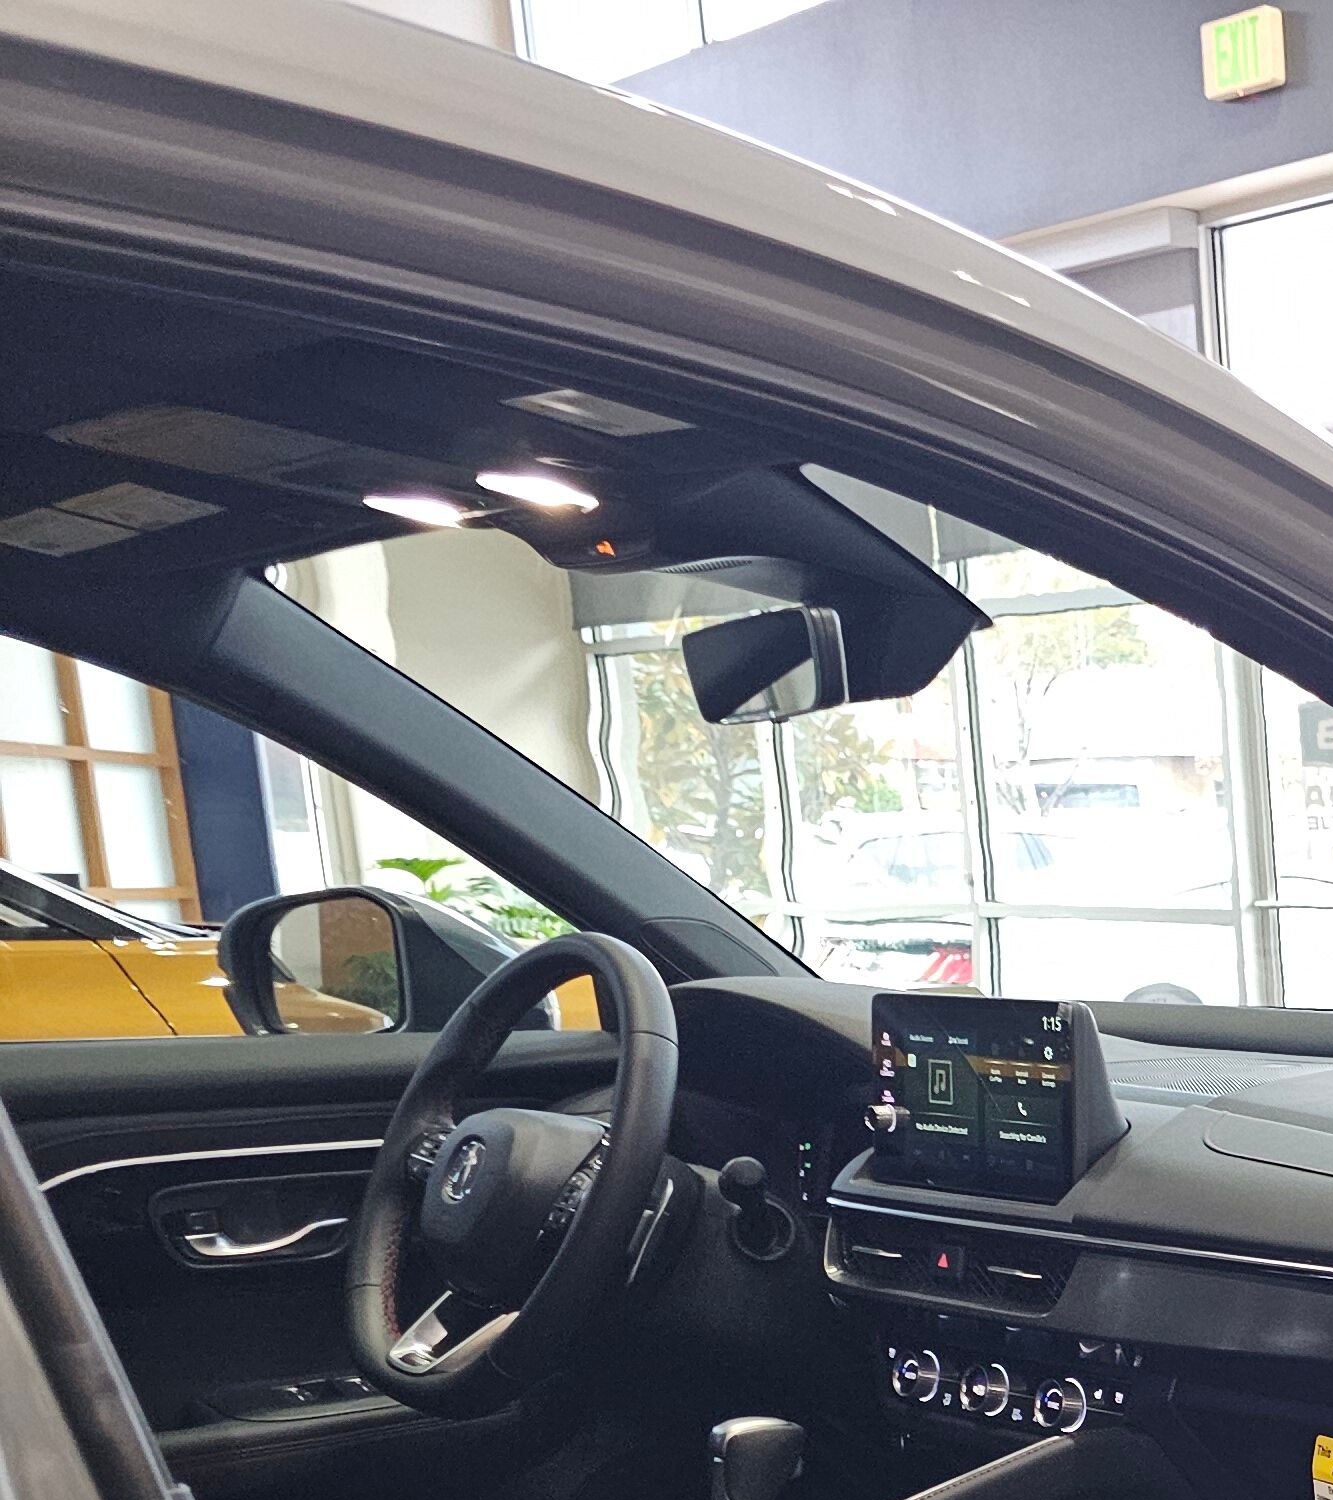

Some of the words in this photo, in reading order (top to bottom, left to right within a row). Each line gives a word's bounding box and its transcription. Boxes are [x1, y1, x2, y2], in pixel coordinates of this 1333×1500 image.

[1214, 15, 1259, 88] EXIT
[1041, 1015, 1063, 1032] 1:15
[1317, 1444, 1331, 1458] This
